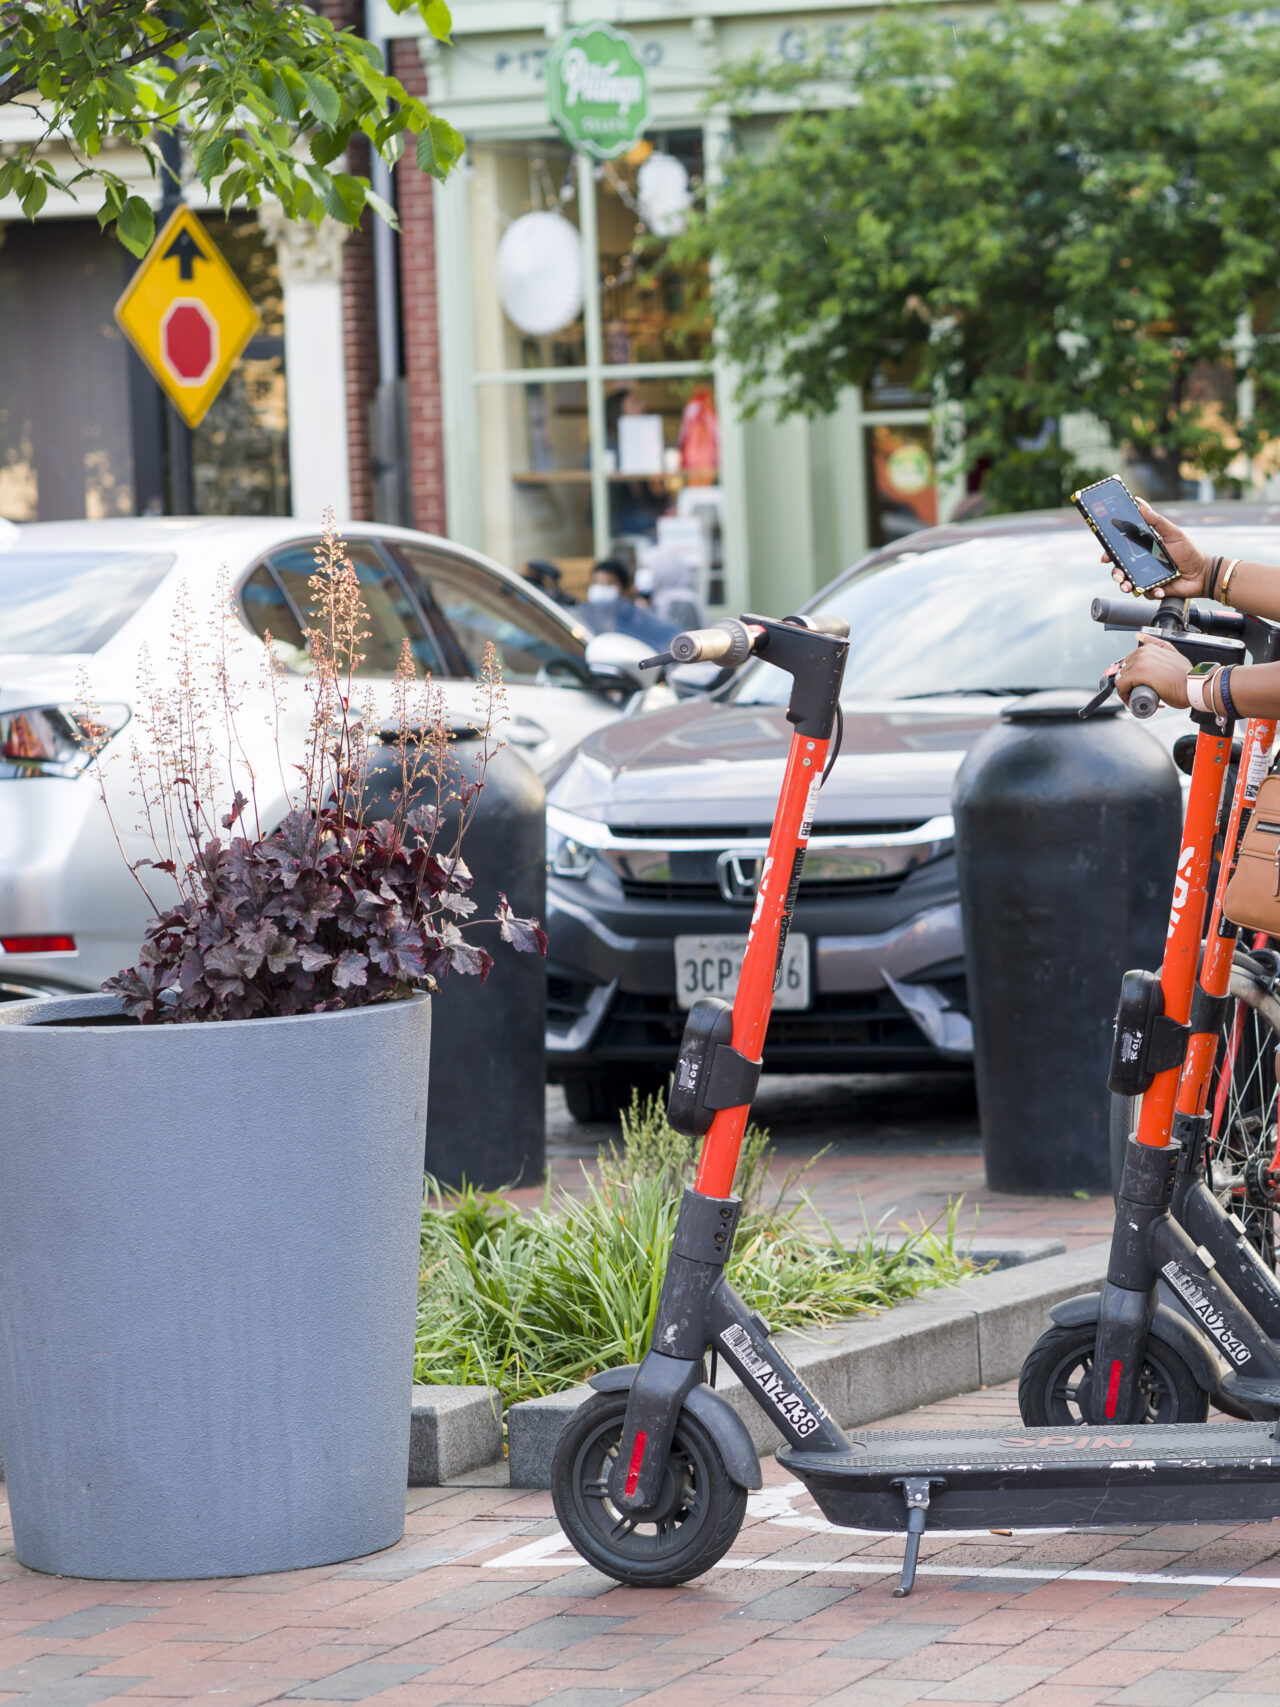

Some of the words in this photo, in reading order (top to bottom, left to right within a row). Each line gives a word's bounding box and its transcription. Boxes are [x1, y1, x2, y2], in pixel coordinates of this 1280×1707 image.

[1167, 846, 1195, 939] SP
[684, 957, 800, 992] 3CP6
[1196, 1304, 1249, 1362] A07640
[756, 1371, 816, 1435] A14438
[999, 1436, 1134, 1449] SPIN
